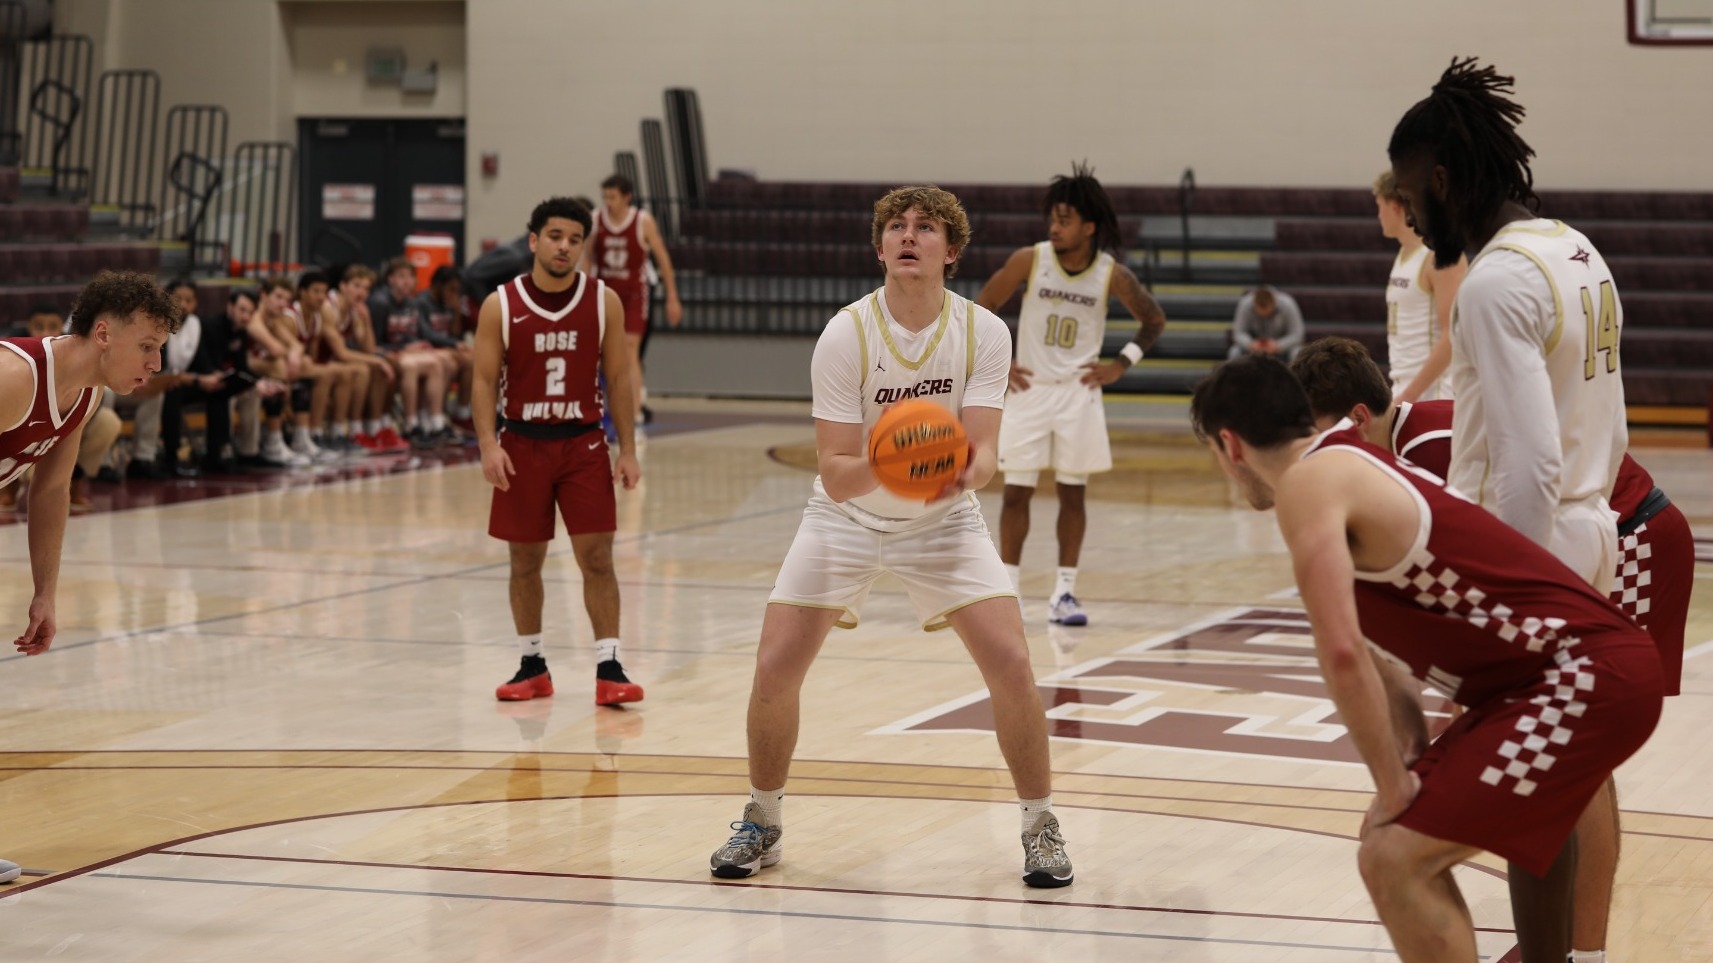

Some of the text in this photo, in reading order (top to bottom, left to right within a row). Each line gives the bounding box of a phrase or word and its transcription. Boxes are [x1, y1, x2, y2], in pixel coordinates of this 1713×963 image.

[1038, 287, 1098, 308] QUAKERS
[534, 330, 578, 353] ROSE
[1044, 313, 1079, 350] 10
[1580, 279, 1619, 382] 14
[545, 357, 567, 396] 2
[873, 378, 954, 404] QUAKERS
